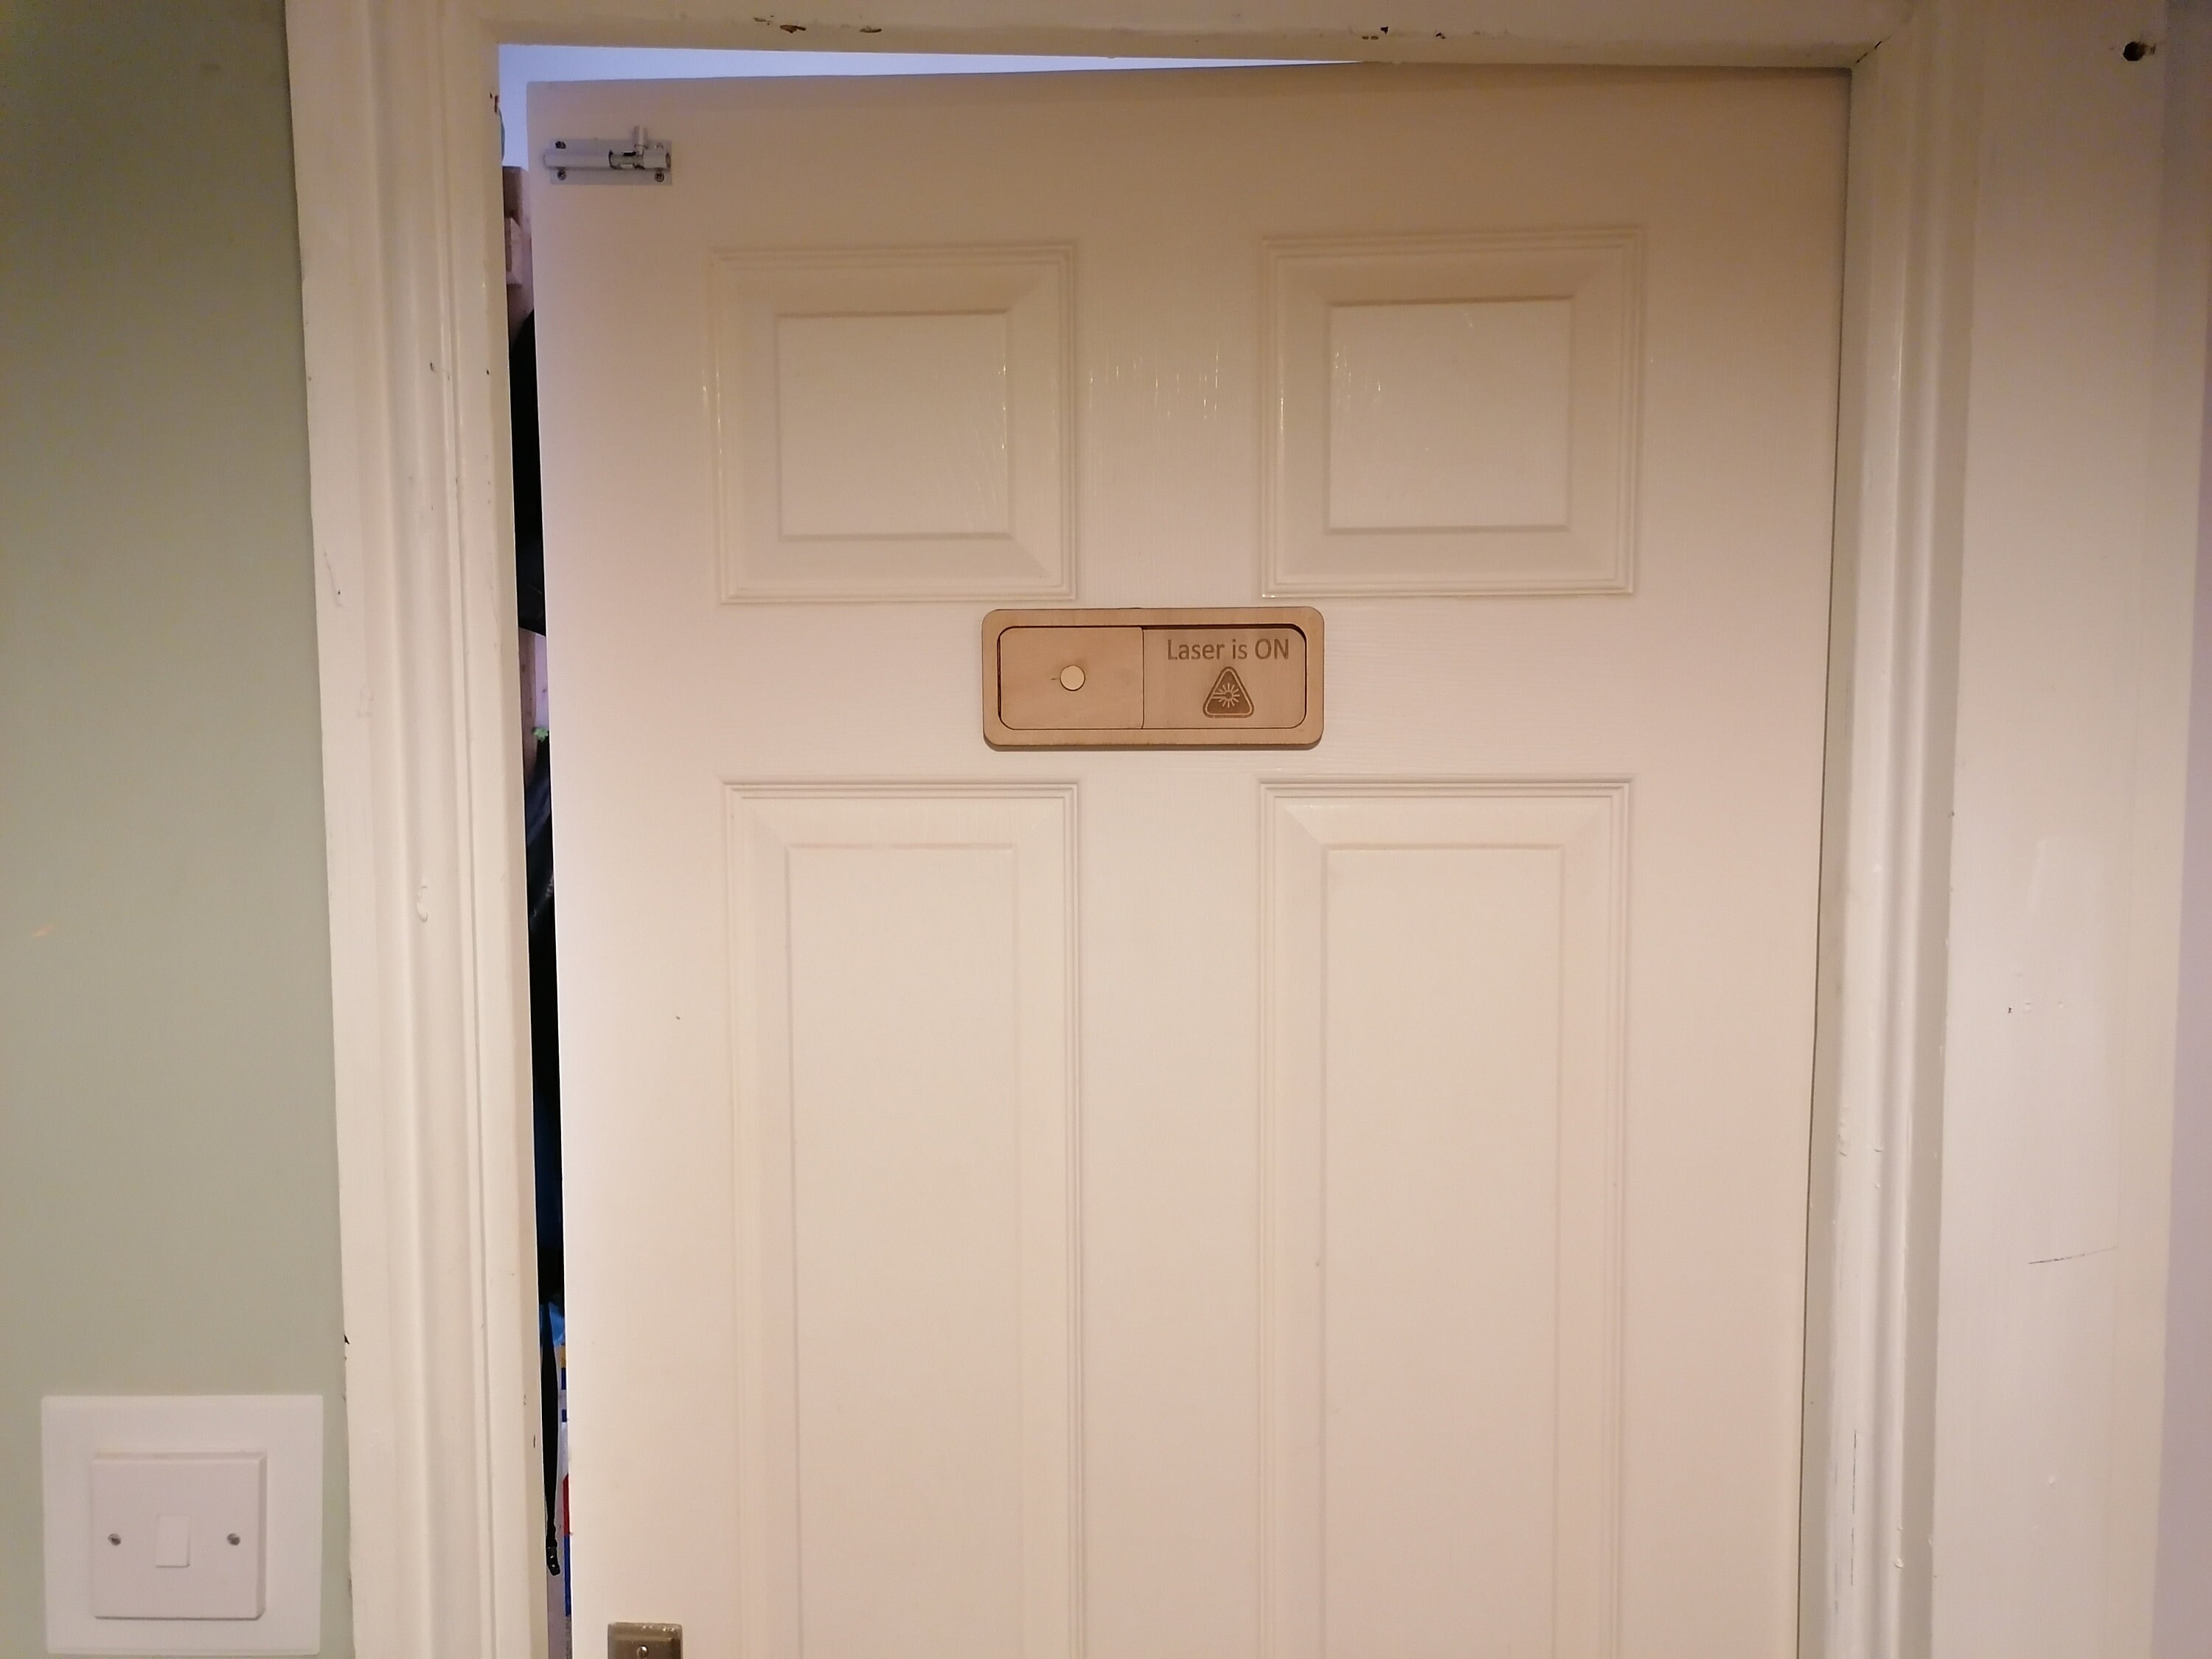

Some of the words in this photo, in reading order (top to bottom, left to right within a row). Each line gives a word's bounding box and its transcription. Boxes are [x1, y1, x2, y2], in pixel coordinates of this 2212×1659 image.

[1168, 639, 1225, 661] Laser
[1232, 639, 1248, 660] is
[1255, 638, 1289, 660] ON
